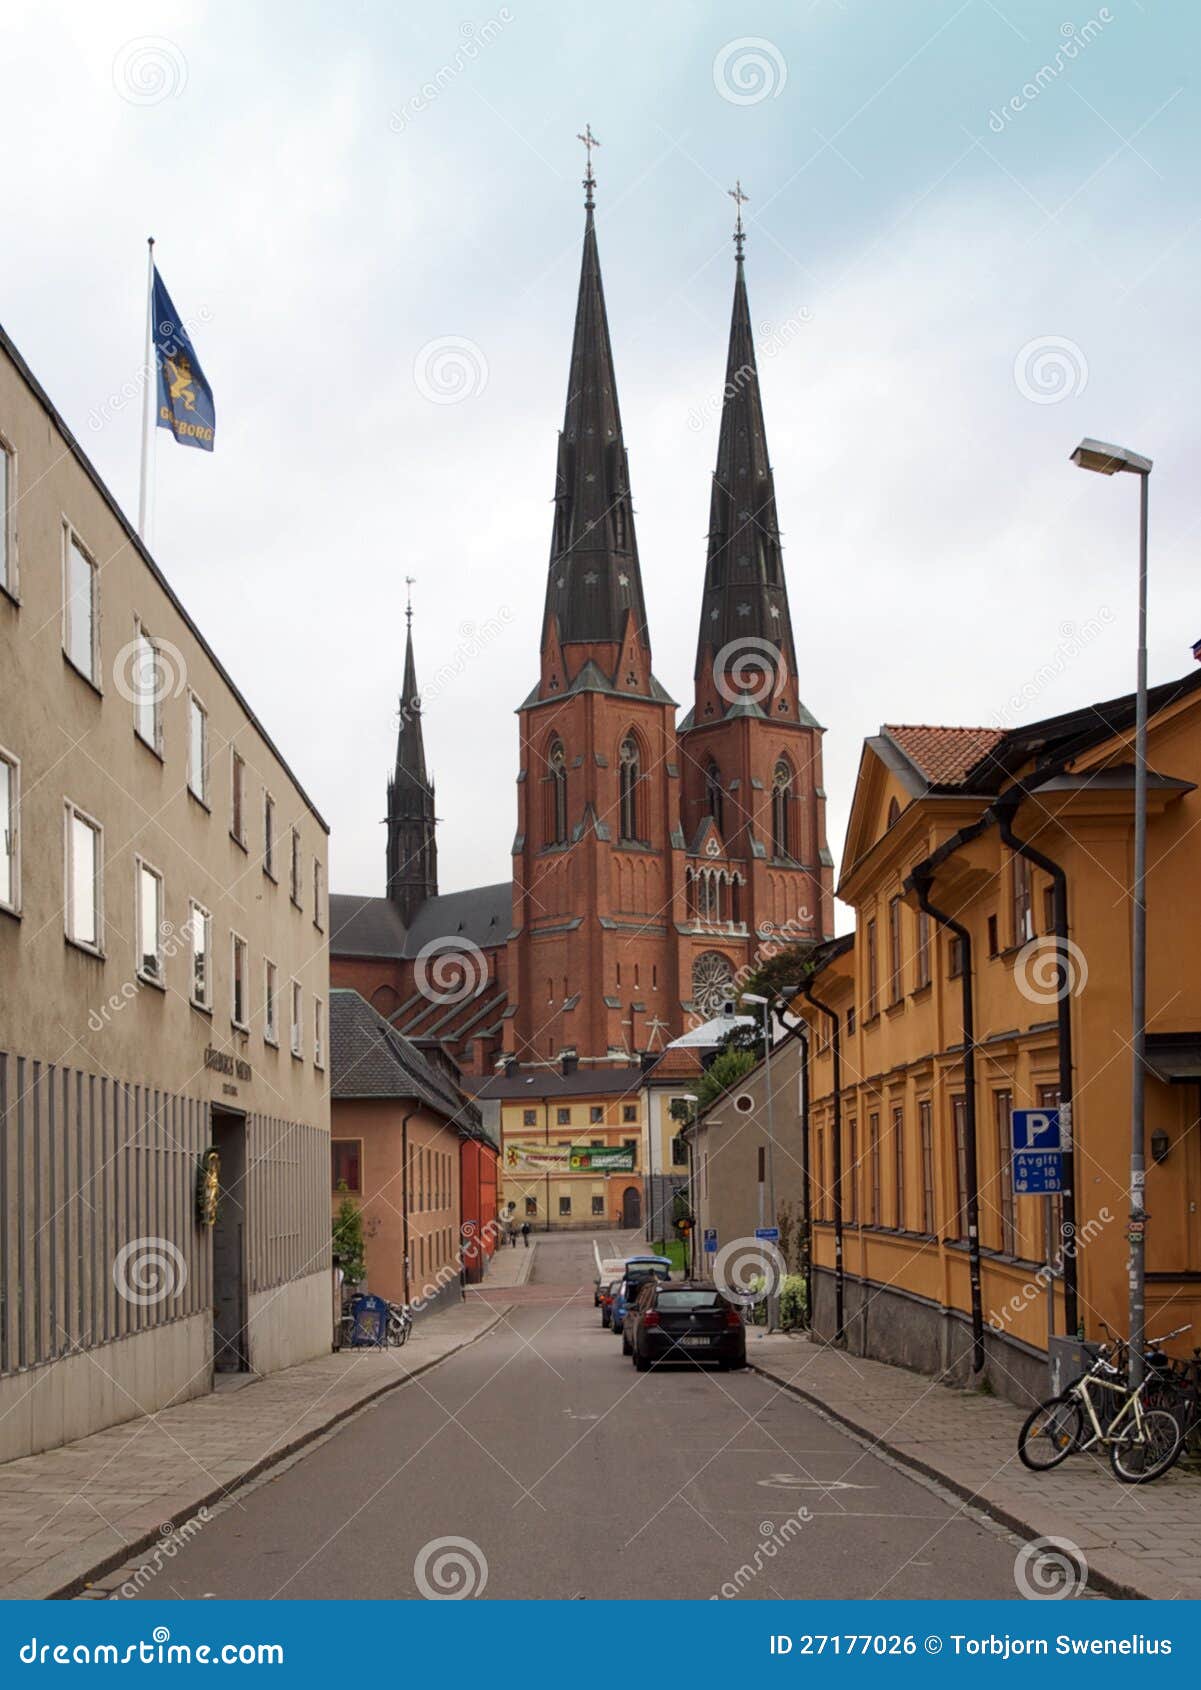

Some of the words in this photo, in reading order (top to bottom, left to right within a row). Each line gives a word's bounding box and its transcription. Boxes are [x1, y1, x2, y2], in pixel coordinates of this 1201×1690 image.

[1026, 1113, 1050, 1147] P
[1018, 1155, 1058, 1168] Avgift
[1019, 1167, 1028, 1178] 8
[1044, 1167, 1056, 1177] 18
